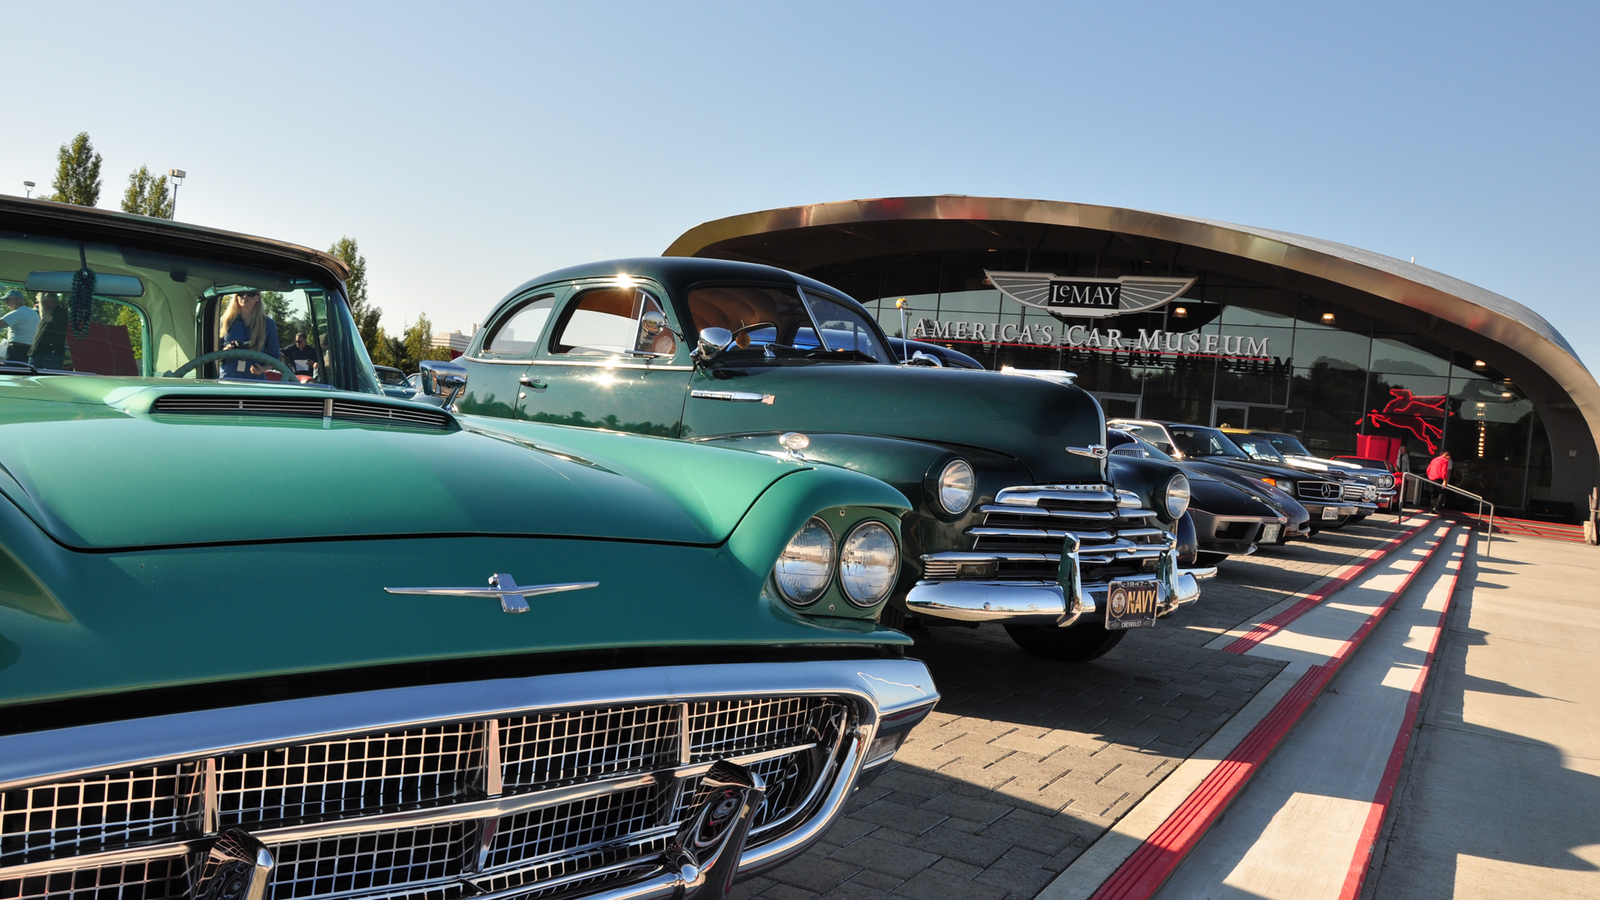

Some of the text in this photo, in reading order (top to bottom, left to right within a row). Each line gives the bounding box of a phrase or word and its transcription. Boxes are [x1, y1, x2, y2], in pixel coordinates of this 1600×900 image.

[1051, 284, 1119, 305] LeMAY
[913, 318, 1270, 357] AMERICA'S CAR MUSEUM
[1126, 590, 1156, 614] NAVY
